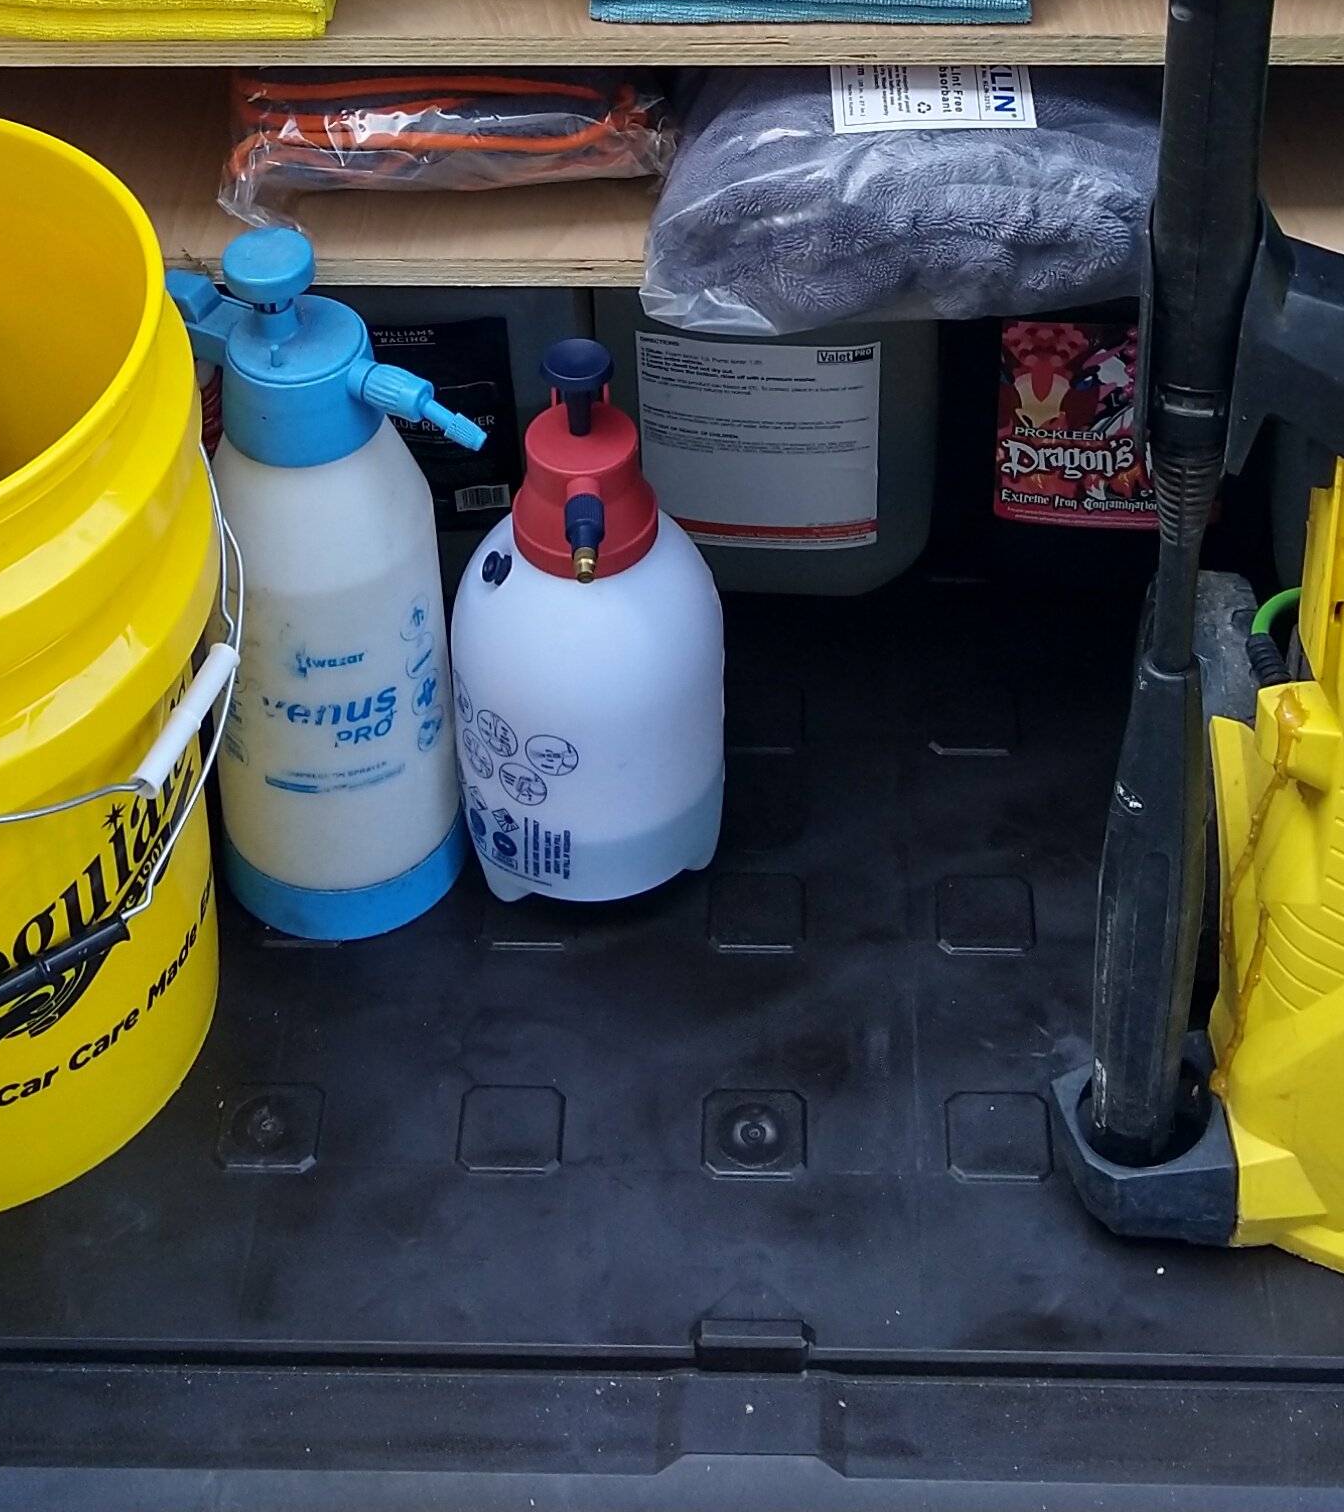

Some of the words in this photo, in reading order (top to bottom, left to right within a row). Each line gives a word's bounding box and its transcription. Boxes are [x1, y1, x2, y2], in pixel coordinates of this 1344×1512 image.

[951, 66, 963, 87] Lint
[939, 66, 951, 114] bsorbant
[953, 90, 964, 113] Free
[372, 329, 435, 337] WILLIAMS
[380, 336, 428, 344] RACING
[820, 351, 852, 363] Valet
[855, 347, 872, 357] PRO
[393, 418, 419, 431] LUE
[421, 414, 495, 432] REER
[1014, 426, 1104, 441] PRO-KLEEN
[1001, 438, 1134, 480] Dragon's
[1001, 488, 1050, 505] Extreme
[1054, 495, 1078, 510] Iron
[68, 1006, 140, 1072] Care
[146, 928, 200, 1013] Made
